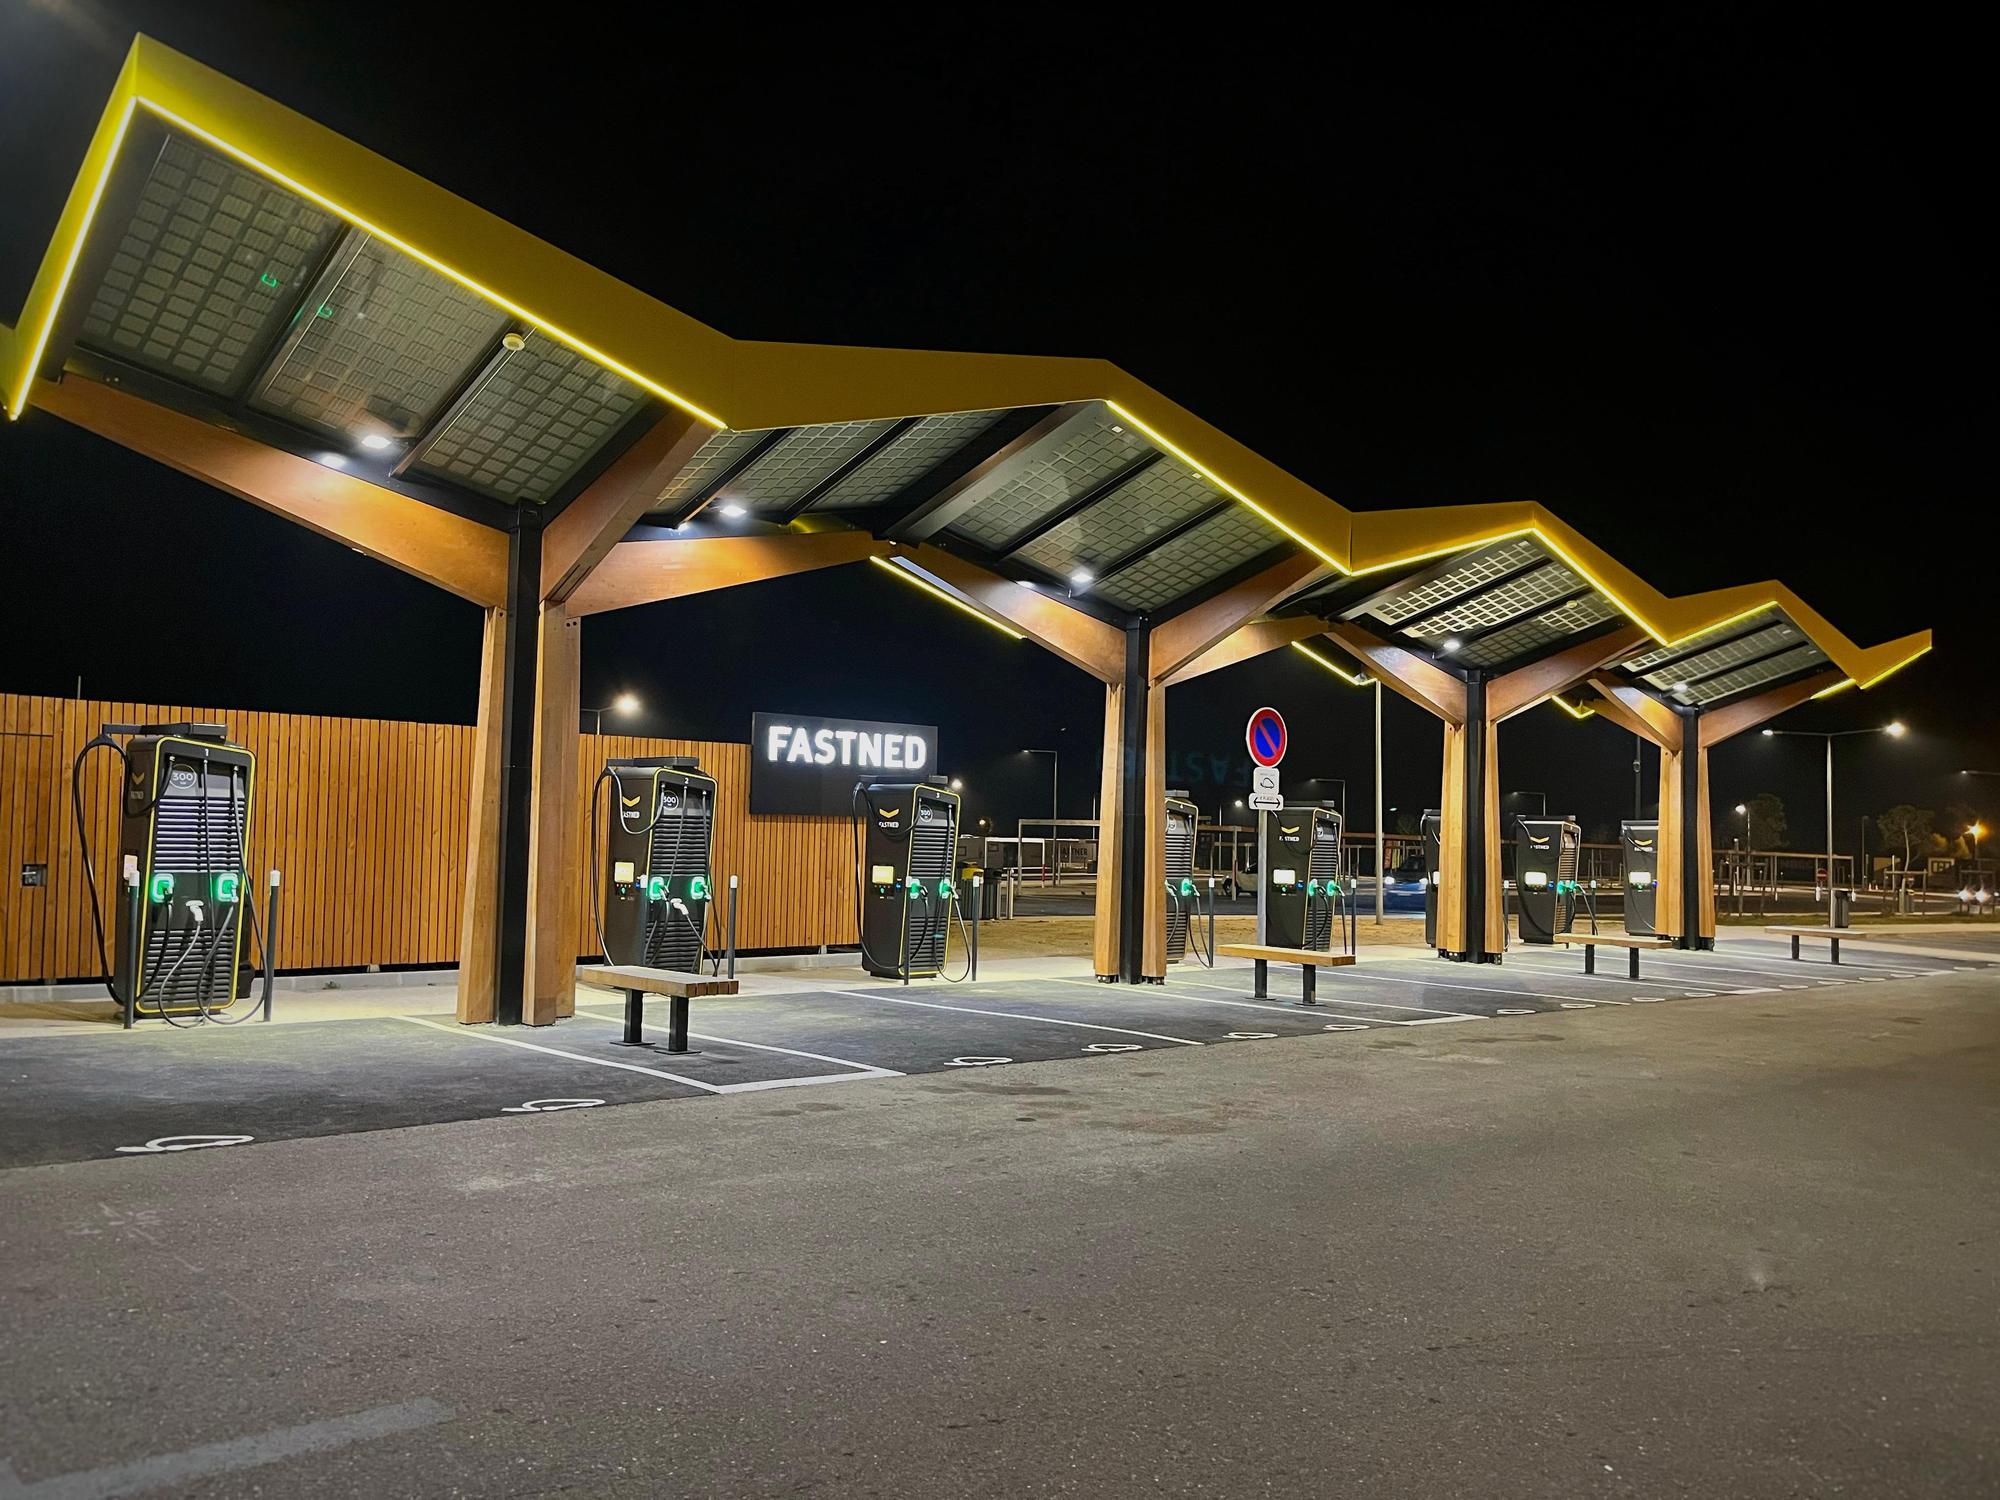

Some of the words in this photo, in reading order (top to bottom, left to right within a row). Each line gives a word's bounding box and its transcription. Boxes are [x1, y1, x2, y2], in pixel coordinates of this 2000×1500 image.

[767, 725, 927, 770] FASTNED
[205, 748, 209, 757] 1
[172, 772, 193, 781] 300
